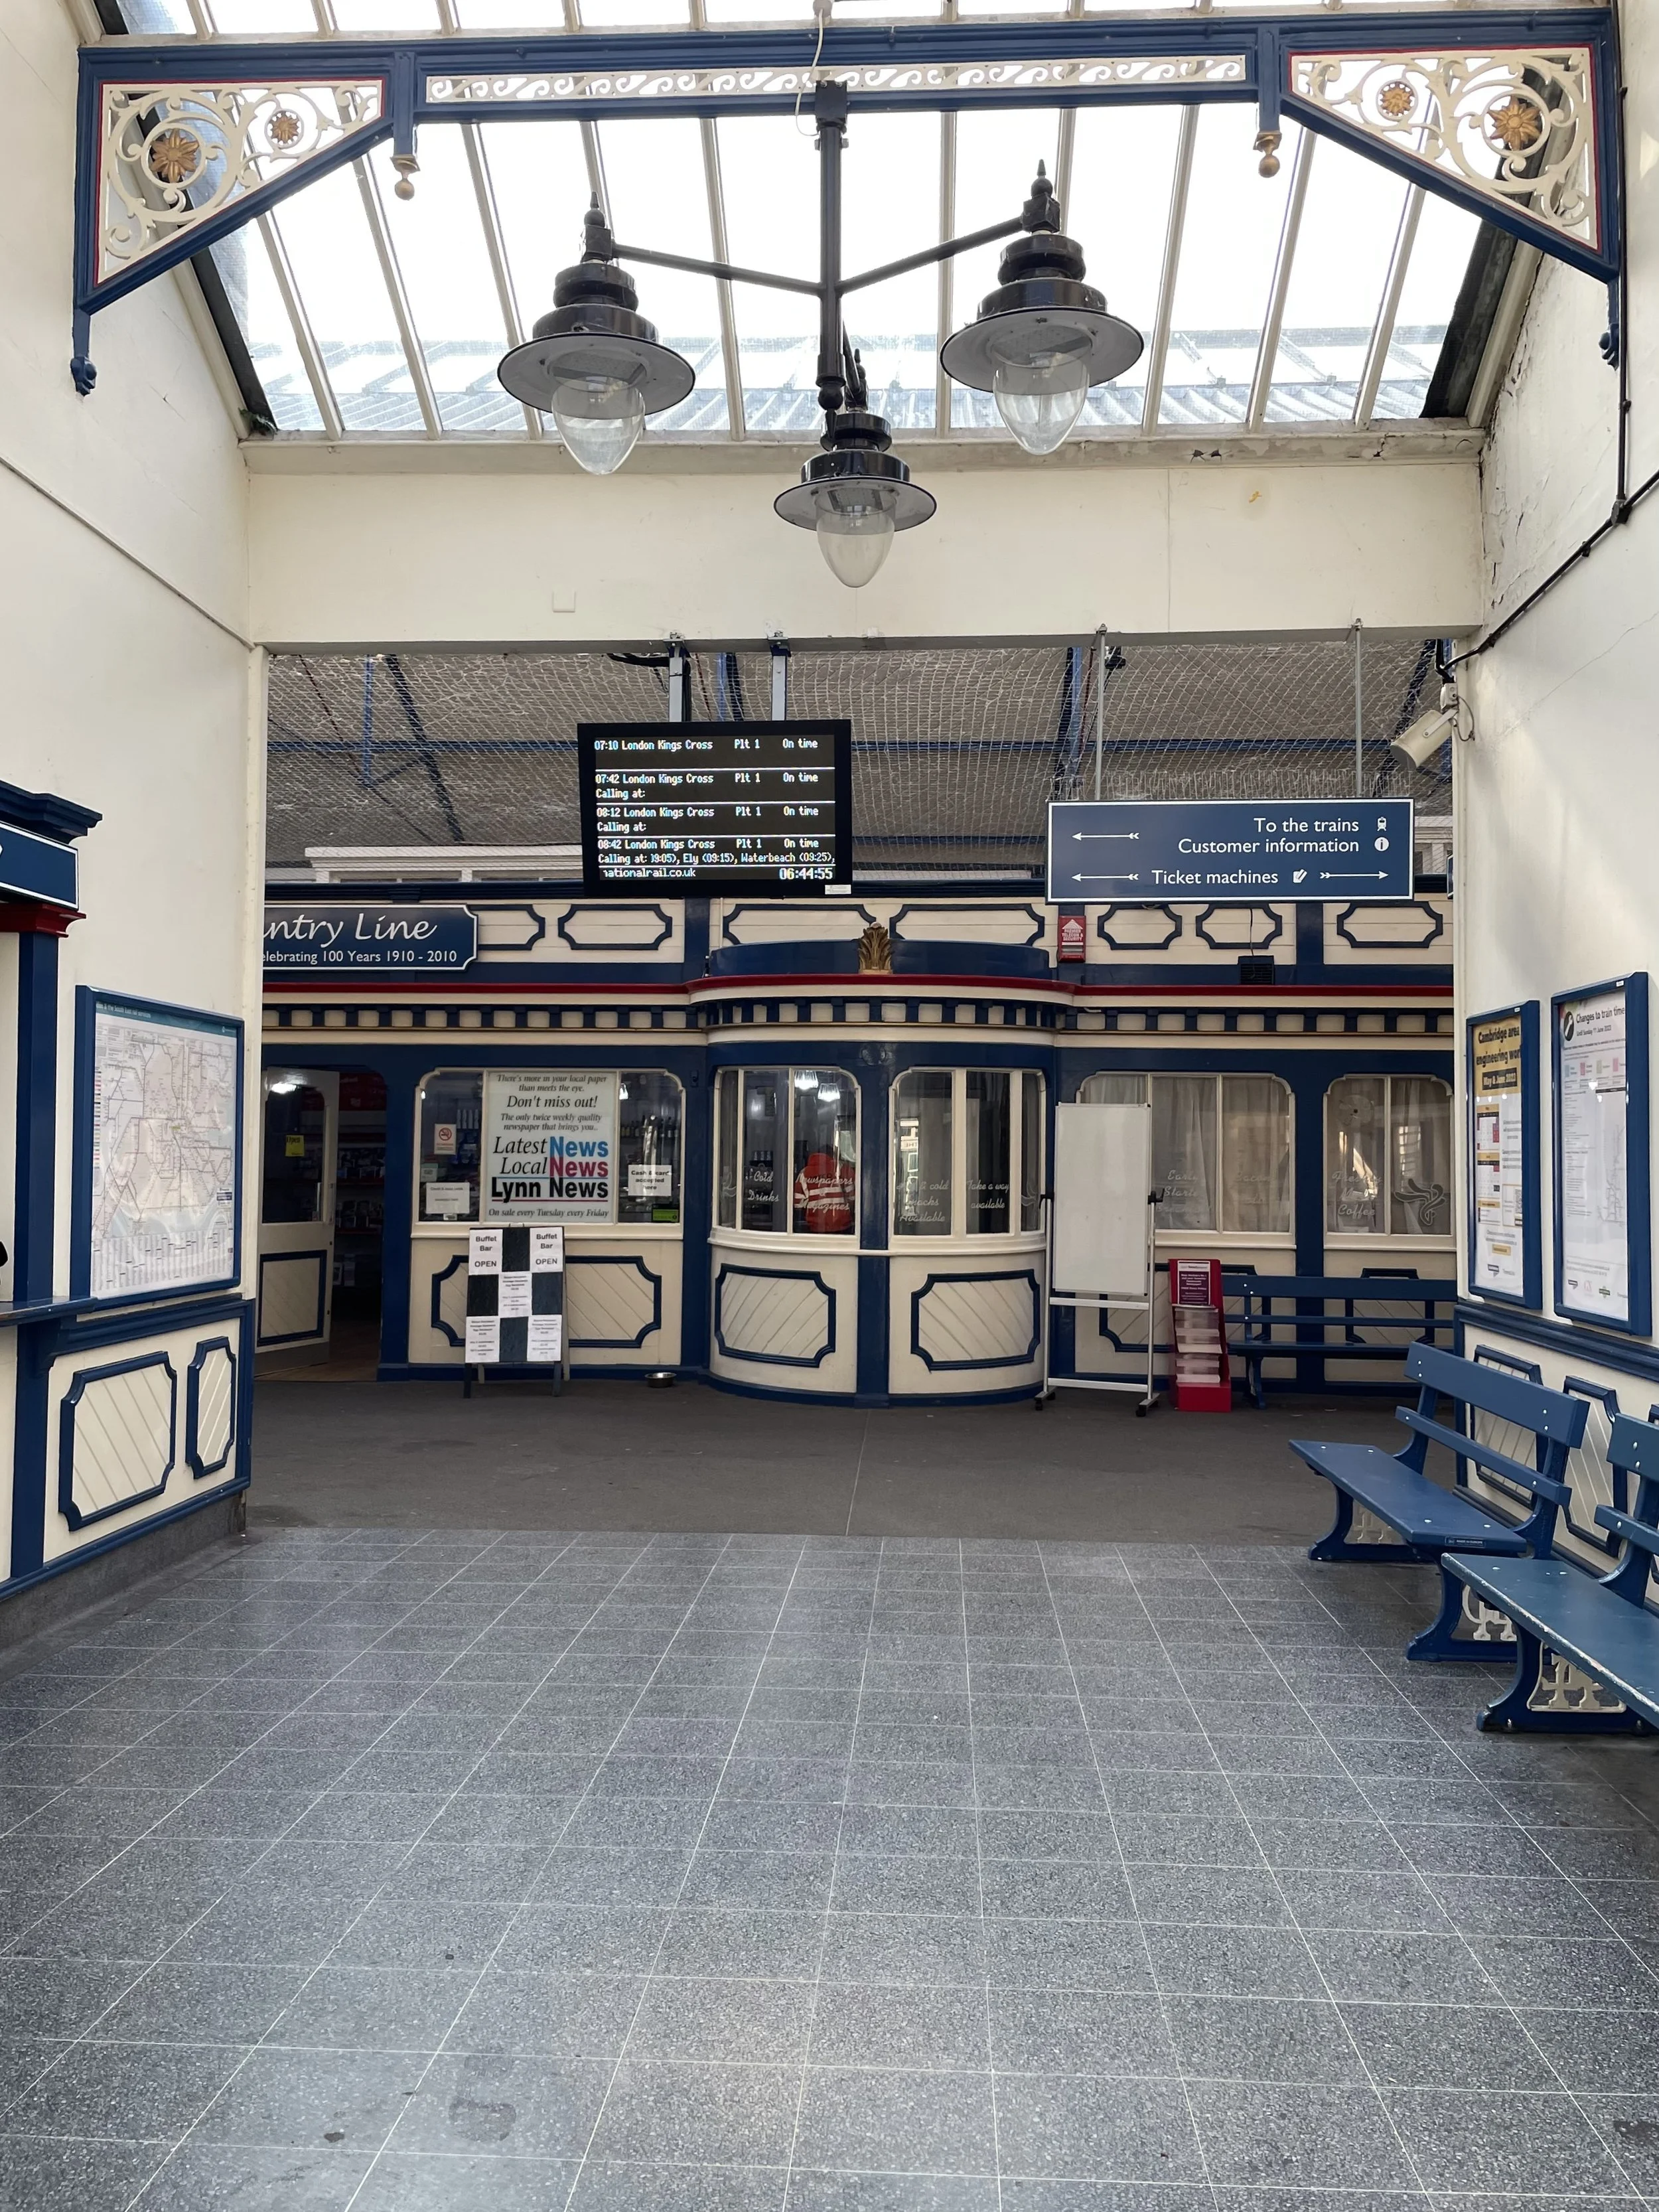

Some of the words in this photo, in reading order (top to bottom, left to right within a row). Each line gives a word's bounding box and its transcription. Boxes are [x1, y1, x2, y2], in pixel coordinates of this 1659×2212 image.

[594, 740, 618, 751] 07:10
[621, 740, 654, 751] London
[658, 740, 682, 752] Kings
[685, 739, 713, 750] Cross
[734, 739, 751, 749] Plt
[755, 739, 760, 749] 1
[782, 738, 794, 749] On
[798, 738, 818, 749] time
[595, 774, 620, 784] 07:42
[622, 774, 656, 784] London
[658, 774, 683, 786] Kings
[686, 773, 713, 783] Cross
[735, 773, 751, 782] Plt
[755, 773, 760, 782] 1
[783, 772, 795, 782] On
[798, 772, 818, 782] time
[595, 788, 629, 800] Calling
[632, 788, 646, 798] at:
[597, 807, 620, 817] 08:12
[624, 807, 656, 817] London
[659, 807, 684, 819] Kings
[687, 807, 715, 817] Cross
[735, 806, 751, 816] Plt
[756, 806, 761, 816] 1
[783, 806, 795, 816] On
[798, 806, 819, 816] time
[597, 822, 630, 834] Calling
[633, 822, 646, 831] at:
[1254, 818, 1277, 832] To
[1282, 817, 1309, 832] the
[1315, 818, 1359, 832] trains
[598, 840, 622, 849] 08:42
[624, 840, 657, 849] London
[660, 839, 685, 851] Kings
[687, 839, 715, 849] Cross
[736, 839, 752, 848] Plt
[757, 839, 762, 848] 1
[784, 838, 796, 848] On
[799, 838, 819, 848] time
[1178, 838, 1260, 853] Customer
[1265, 838, 1359, 853] information
[599, 853, 630, 865] Calling
[634, 853, 647, 863] at:
[683, 853, 699, 865] Ely
[702, 853, 737, 864] (09:15),
[741, 852, 796, 862] Waterbeach
[779, 867, 833, 879] 06:44:55
[1151, 869, 1201, 885] Ticket
[1206, 869, 1279, 884] machines
[354, 913, 438, 940] Line
[323, 950, 344, 962] 100
[347, 950, 382, 962] Years
[387, 950, 414, 962] 1910
[427, 950, 457, 962] 2010
[1576, 1013, 1595, 1025] Changes
[1595, 1011, 1601, 1019] to
[1601, 1007, 1613, 1018] train
[1479, 1027, 1507, 1044] Cambridge
[1508, 1026, 1520, 1037] area
[1476, 1049, 1508, 1068] engineering
[587, 1076, 607, 1084] paper
[507, 1095, 541, 1108] Don't
[544, 1095, 571, 1108] miss
[574, 1095, 599, 1108] out!
[516, 1114, 532, 1122] only
[553, 1113, 576, 1123] weekly
[577, 1114, 602, 1123] quality
[504, 1124, 540, 1132] newspaper
[557, 1123, 579, 1132] brings
[492, 1136, 548, 1154] Latest
[549, 1136, 609, 1157] News
[500, 1157, 547, 1175] Local
[549, 1157, 609, 1177] News
[753, 1171, 774, 1183] Cold
[795, 1173, 853, 1187] Newspapers
[492, 1177, 541, 1203] Lynn
[549, 1177, 609, 1198] News
[930, 1179, 949, 1190] cold
[967, 1179, 986, 1190] Take
[995, 1184, 1010, 1193] way
[748, 1189, 780, 1203] Drinks
[906, 1195, 939, 1206] nacks
[798, 1199, 850, 1213] Magazines
[971, 1198, 1005, 1209] available
[537, 1209, 565, 1218] Tuesday
[567, 1210, 585, 1218] every
[586, 1209, 609, 1218] Friday
[899, 1211, 945, 1222] Available
[1338, 1203, 1376, 1219] Coffee
